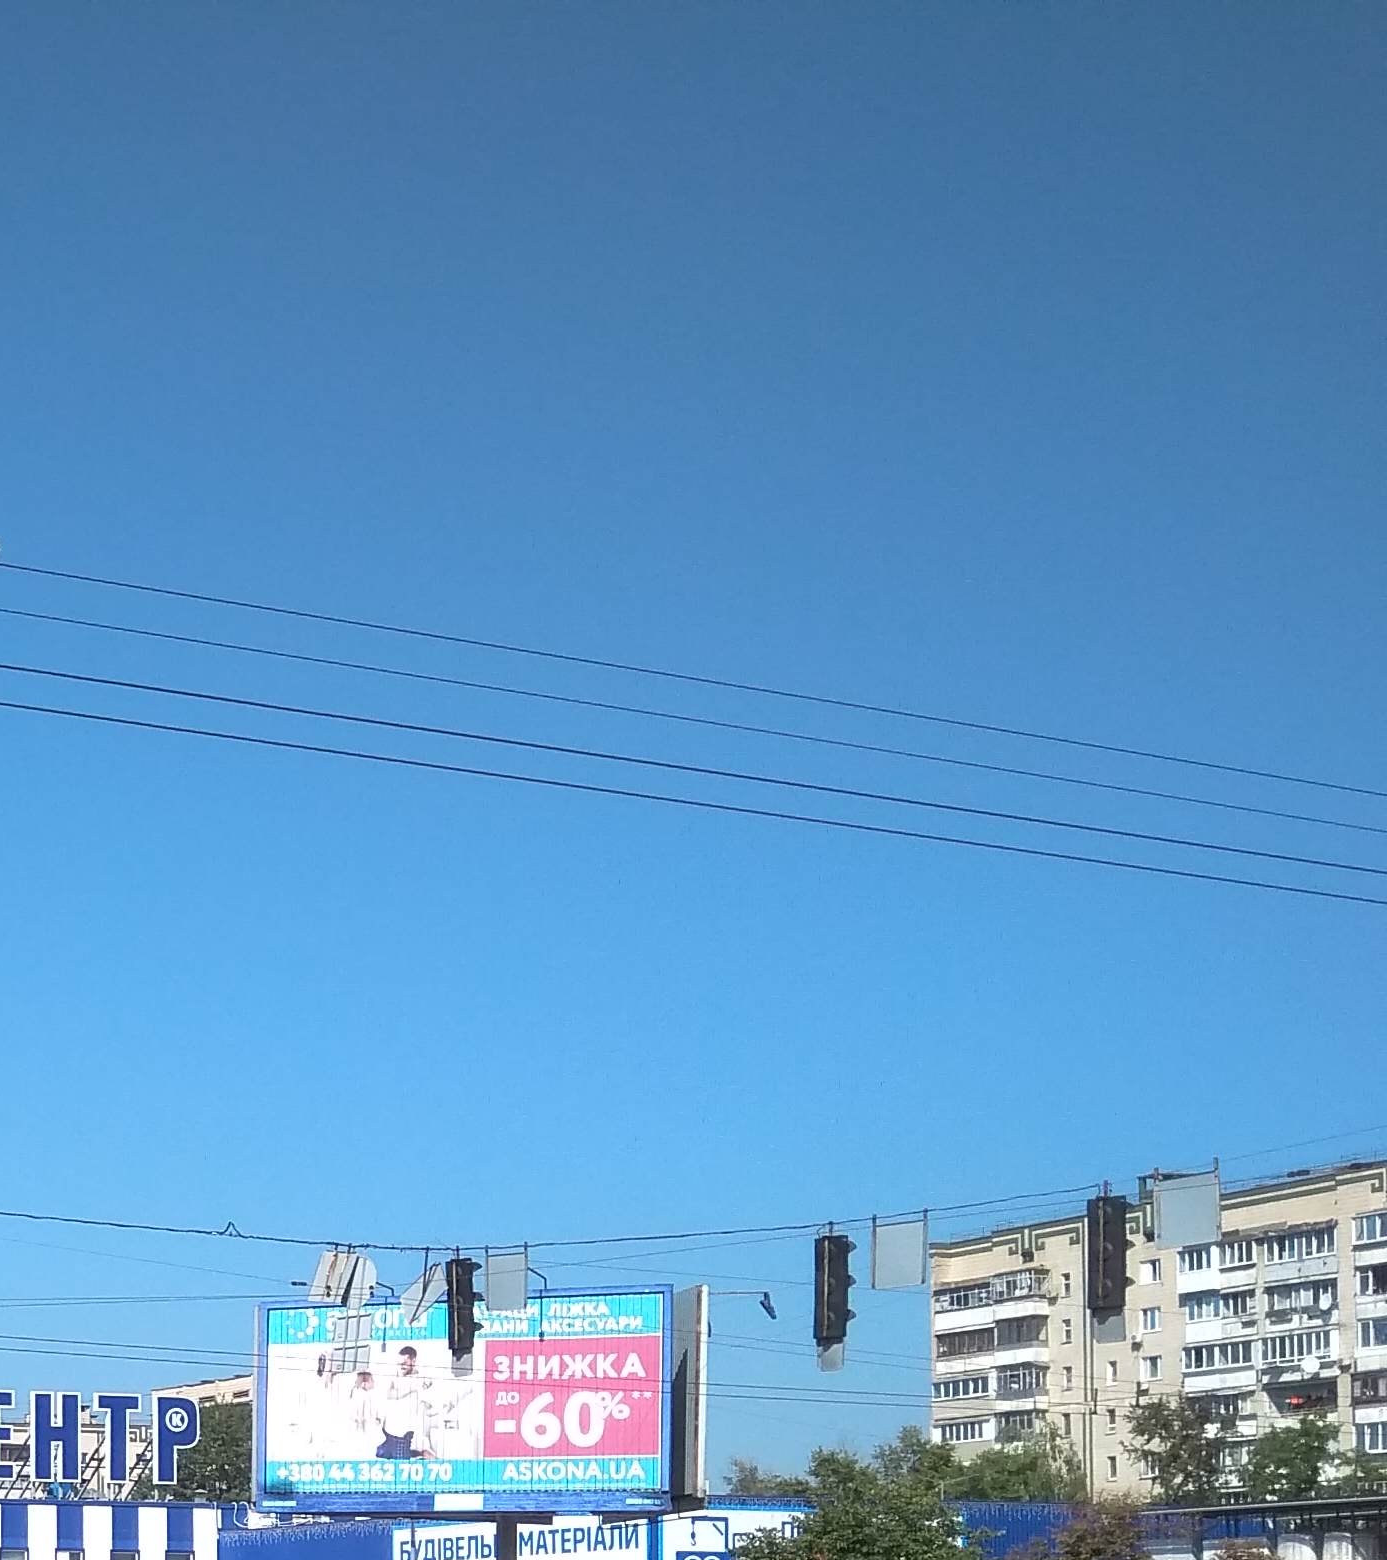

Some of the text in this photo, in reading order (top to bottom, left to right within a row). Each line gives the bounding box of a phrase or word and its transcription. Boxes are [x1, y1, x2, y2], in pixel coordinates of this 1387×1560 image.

[548, 1301, 610, 1317] ЛІЖКА
[540, 1315, 644, 1333] АКСЕСУАРИ
[492, 1352, 647, 1381] ЗНИЖКА
[276, 1463, 453, 1482] +380 44 362 70 70
[502, 1460, 646, 1482] ASKONA.UA
[518, 1523, 640, 1557] МАТЕРІАЛИ
